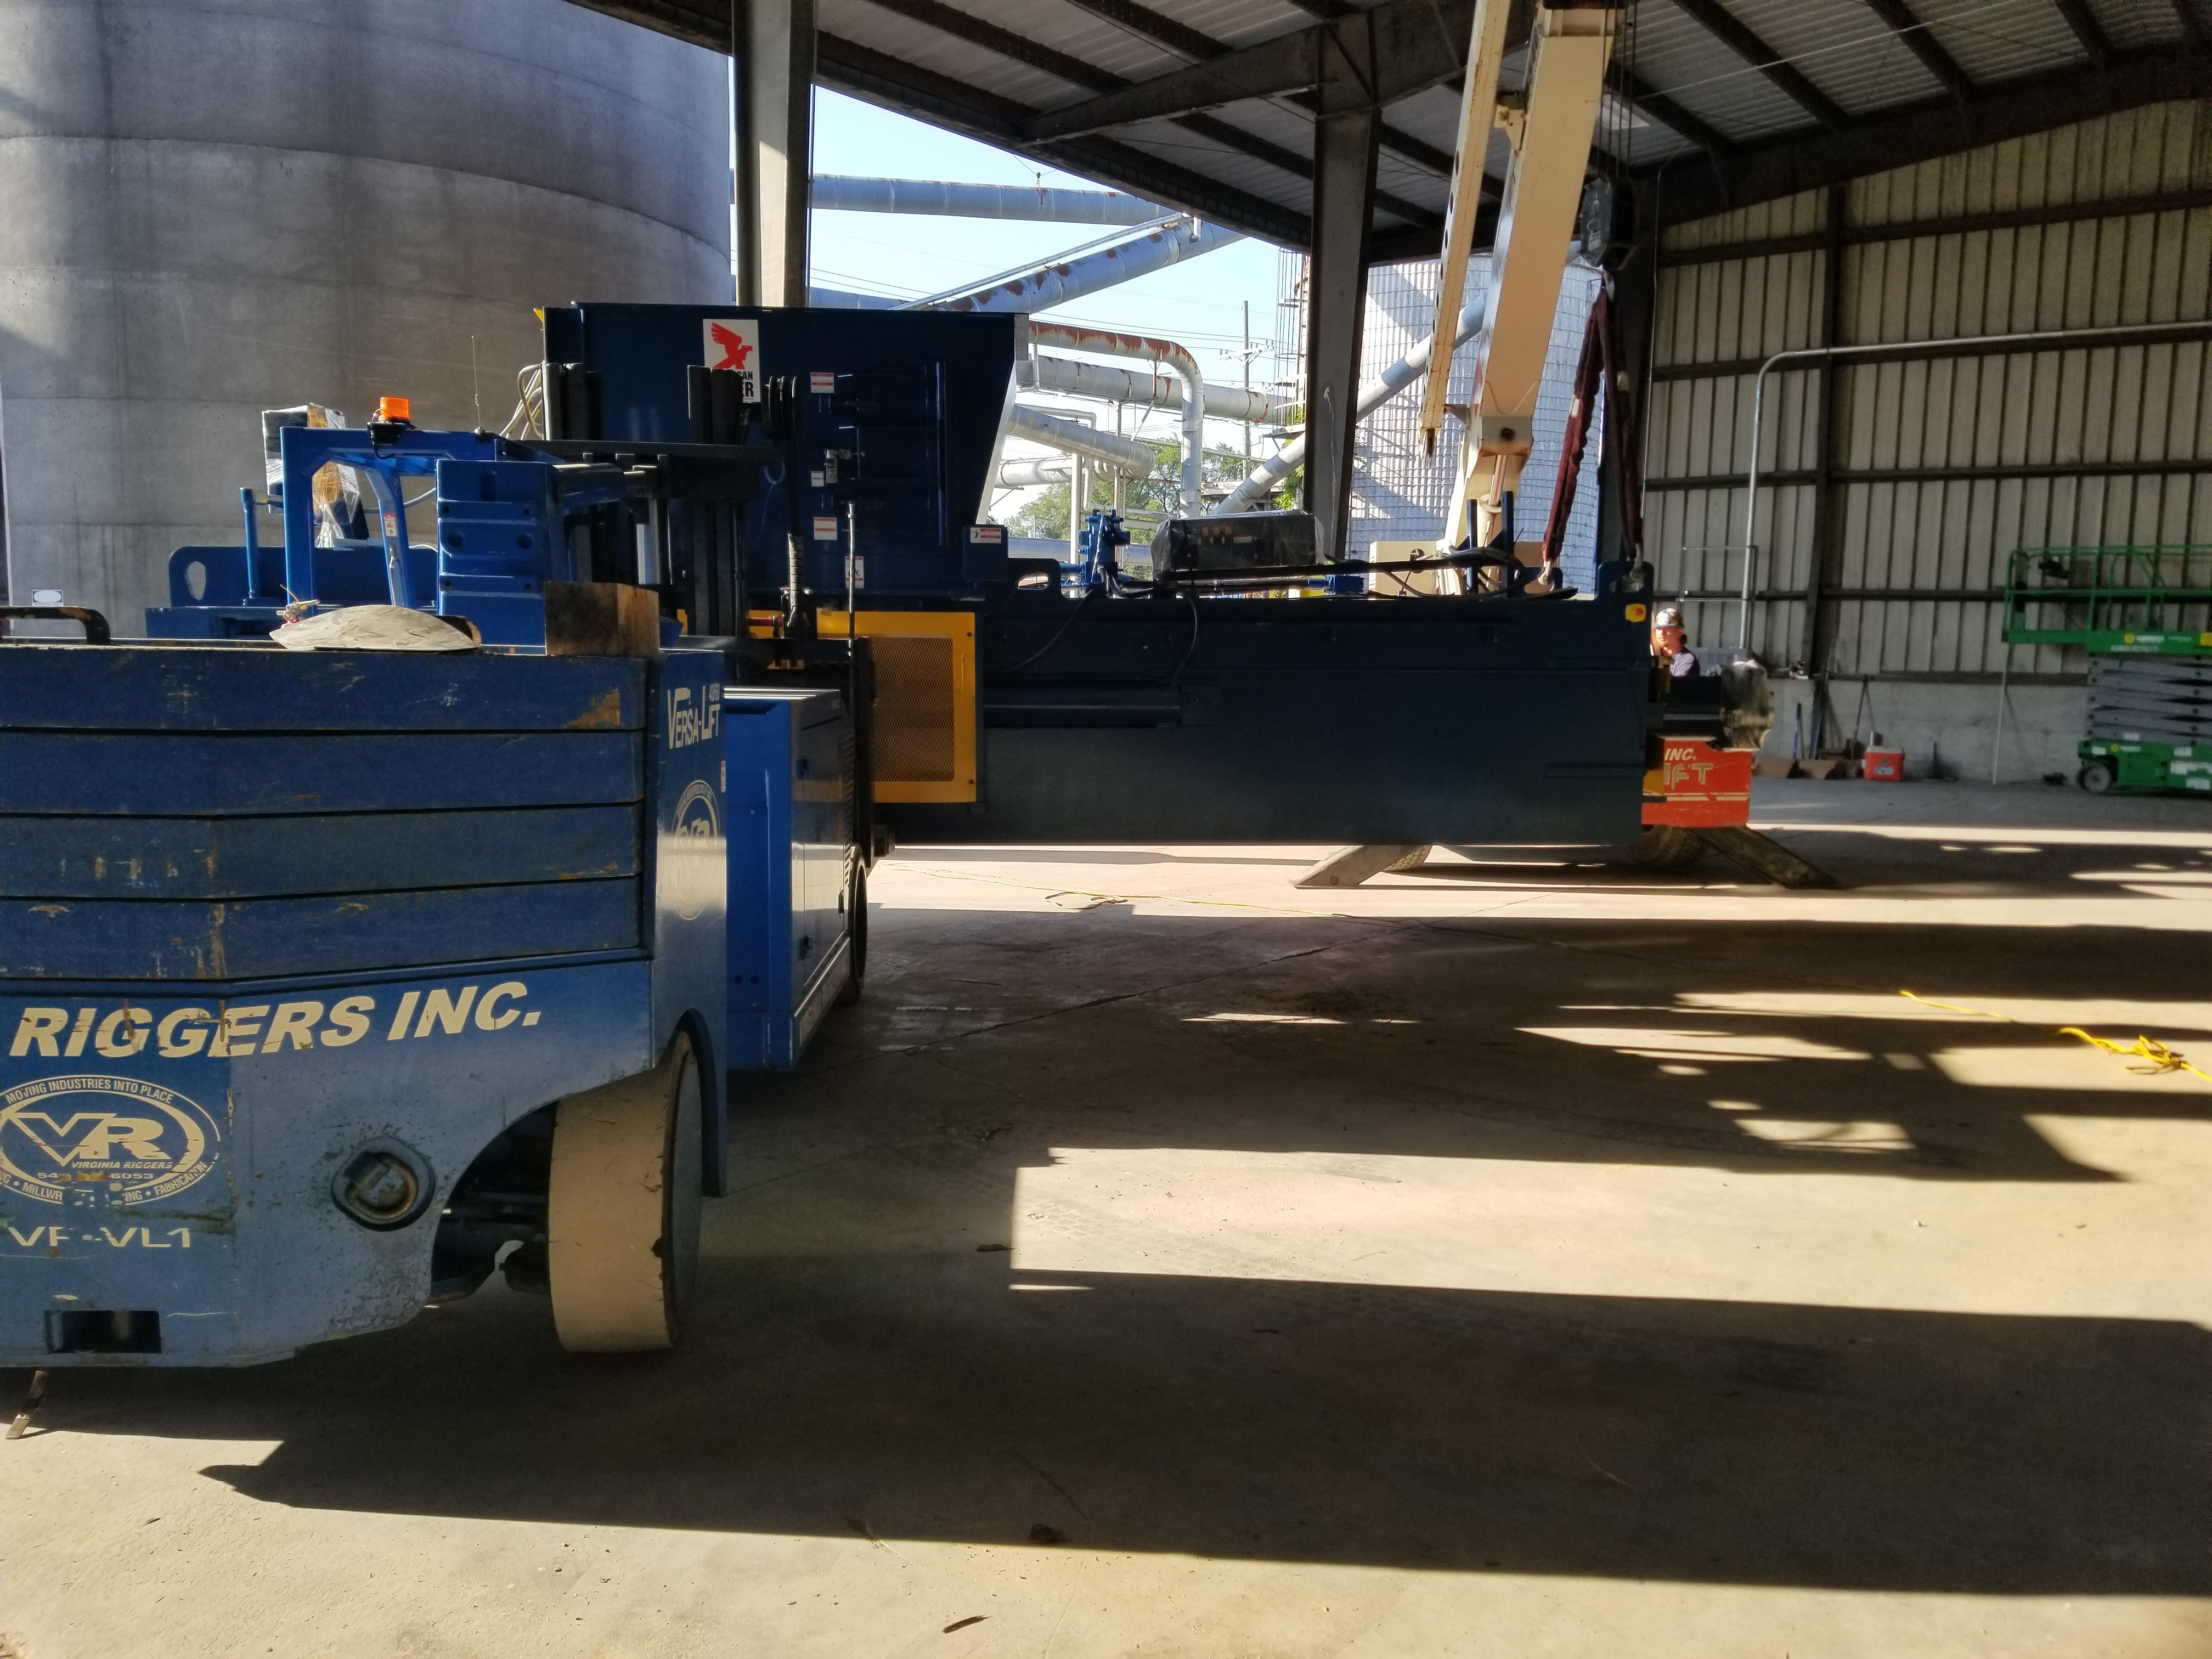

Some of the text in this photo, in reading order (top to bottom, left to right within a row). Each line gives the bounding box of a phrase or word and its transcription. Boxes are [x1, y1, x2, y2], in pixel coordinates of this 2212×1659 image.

[1664, 748, 1696, 761] INC.
[9, 981, 541, 1058] RIGGERS INC.
[5, 1079, 174, 1104] MOVING INDUSTRIES INTO PLACE
[4, 1112, 172, 1167] VR
